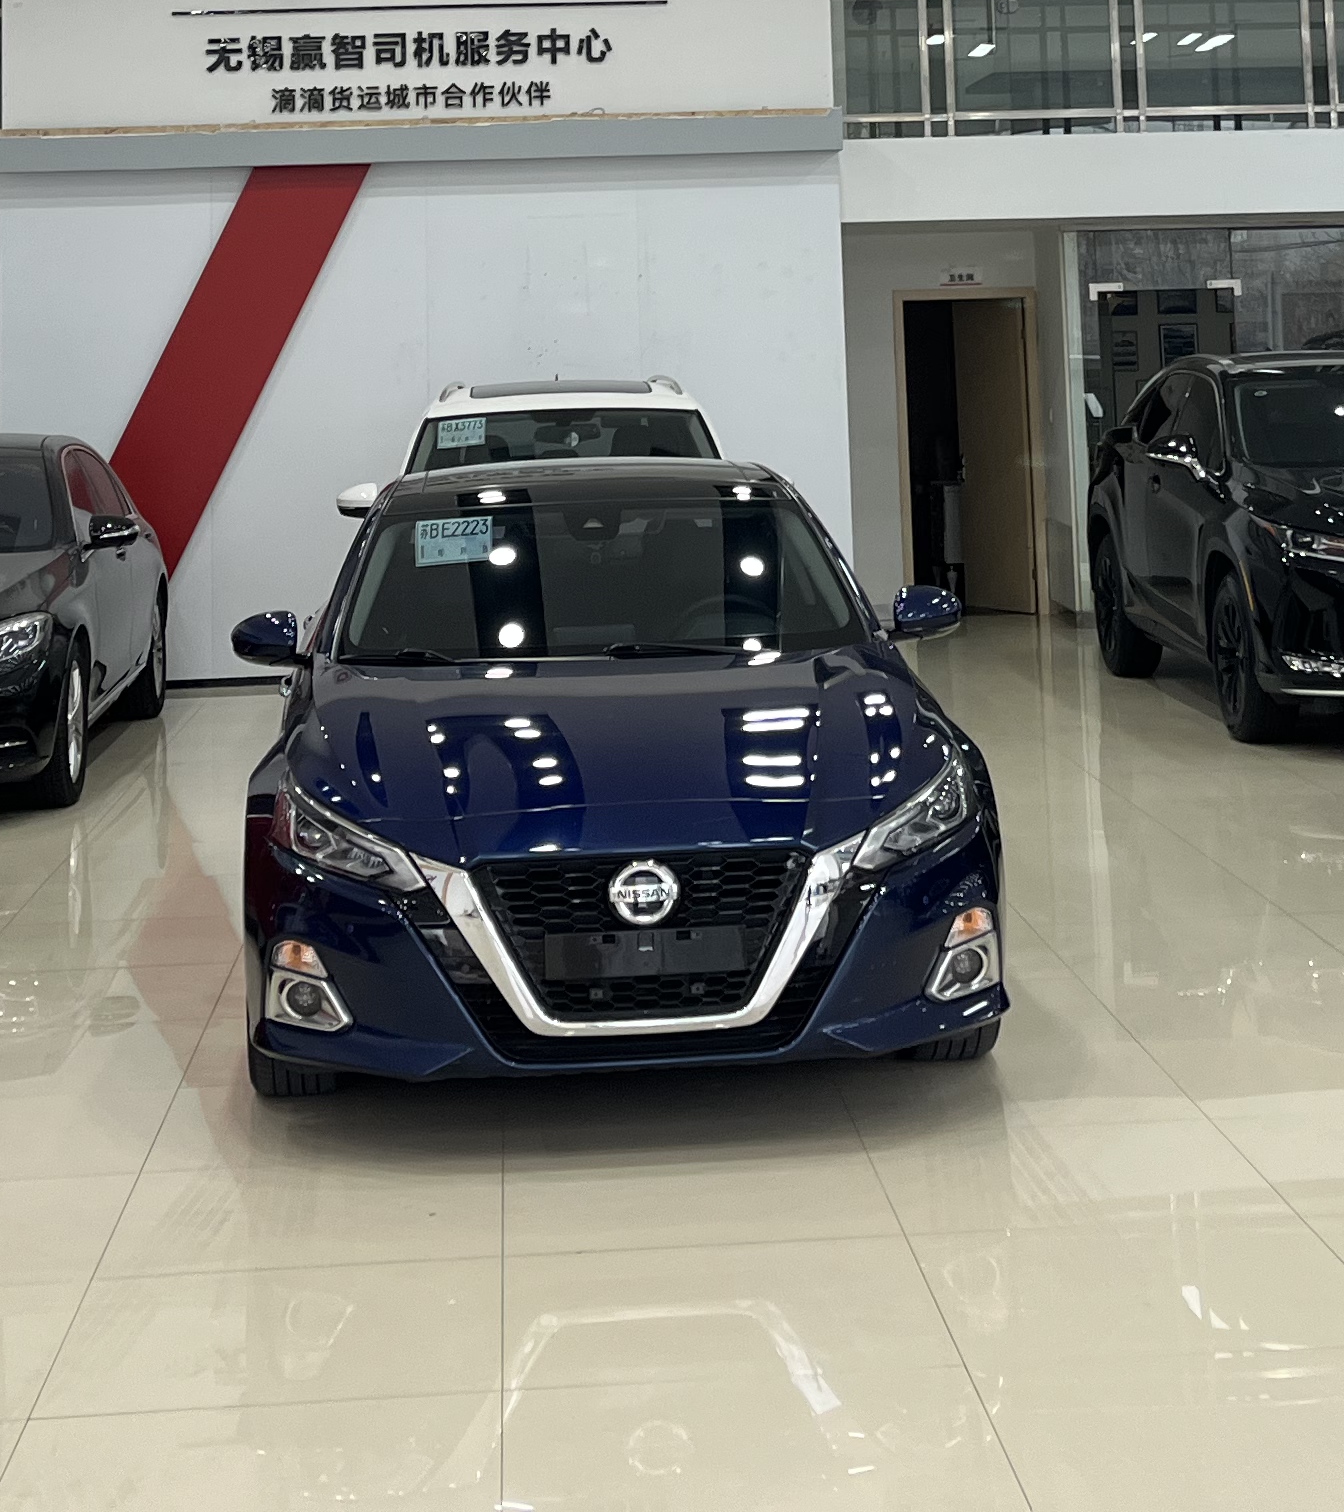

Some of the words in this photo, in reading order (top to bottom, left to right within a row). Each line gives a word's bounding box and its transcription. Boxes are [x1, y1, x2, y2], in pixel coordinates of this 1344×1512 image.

[205, 28, 613, 73] 无锡赢智司机服务中心
[270, 80, 551, 114] 滴滴货运城市合作伙伴
[617, 888, 670, 899] NISSAN
